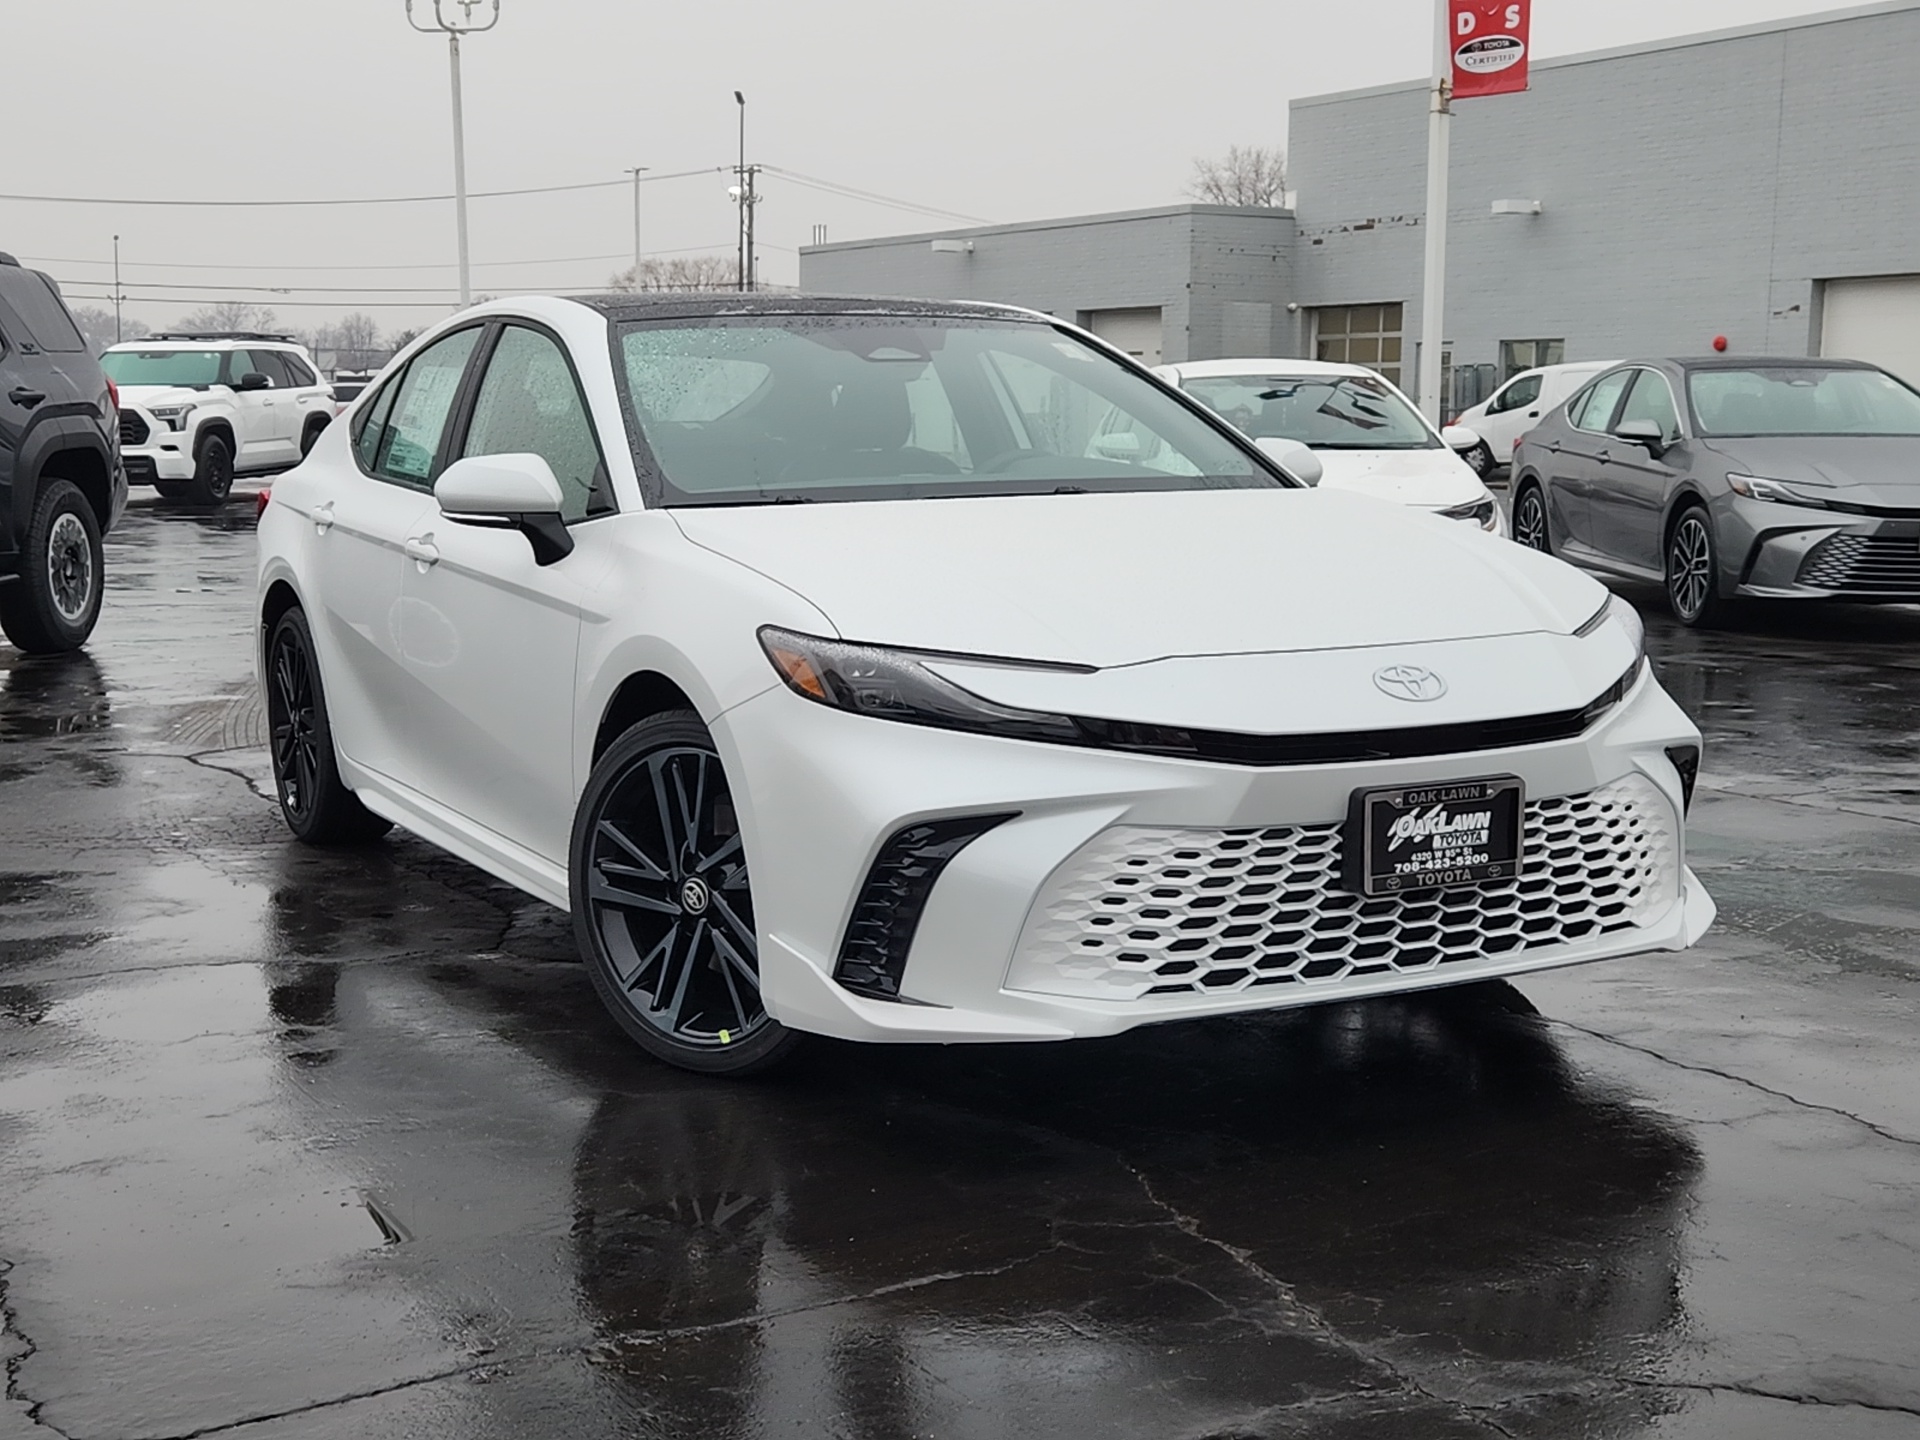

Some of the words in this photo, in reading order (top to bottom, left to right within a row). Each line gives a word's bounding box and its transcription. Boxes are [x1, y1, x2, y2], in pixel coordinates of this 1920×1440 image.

[1484, 40, 1510, 49] TOYOTA
[1409, 791, 1437, 804] OAK
[1440, 786, 1480, 800] LAWN
[1439, 831, 1483, 848] TOYOTA
[1434, 850, 1443, 859] W
[1394, 853, 1489, 874] 708-423-5200
[1416, 868, 1472, 886] TOYOTA
